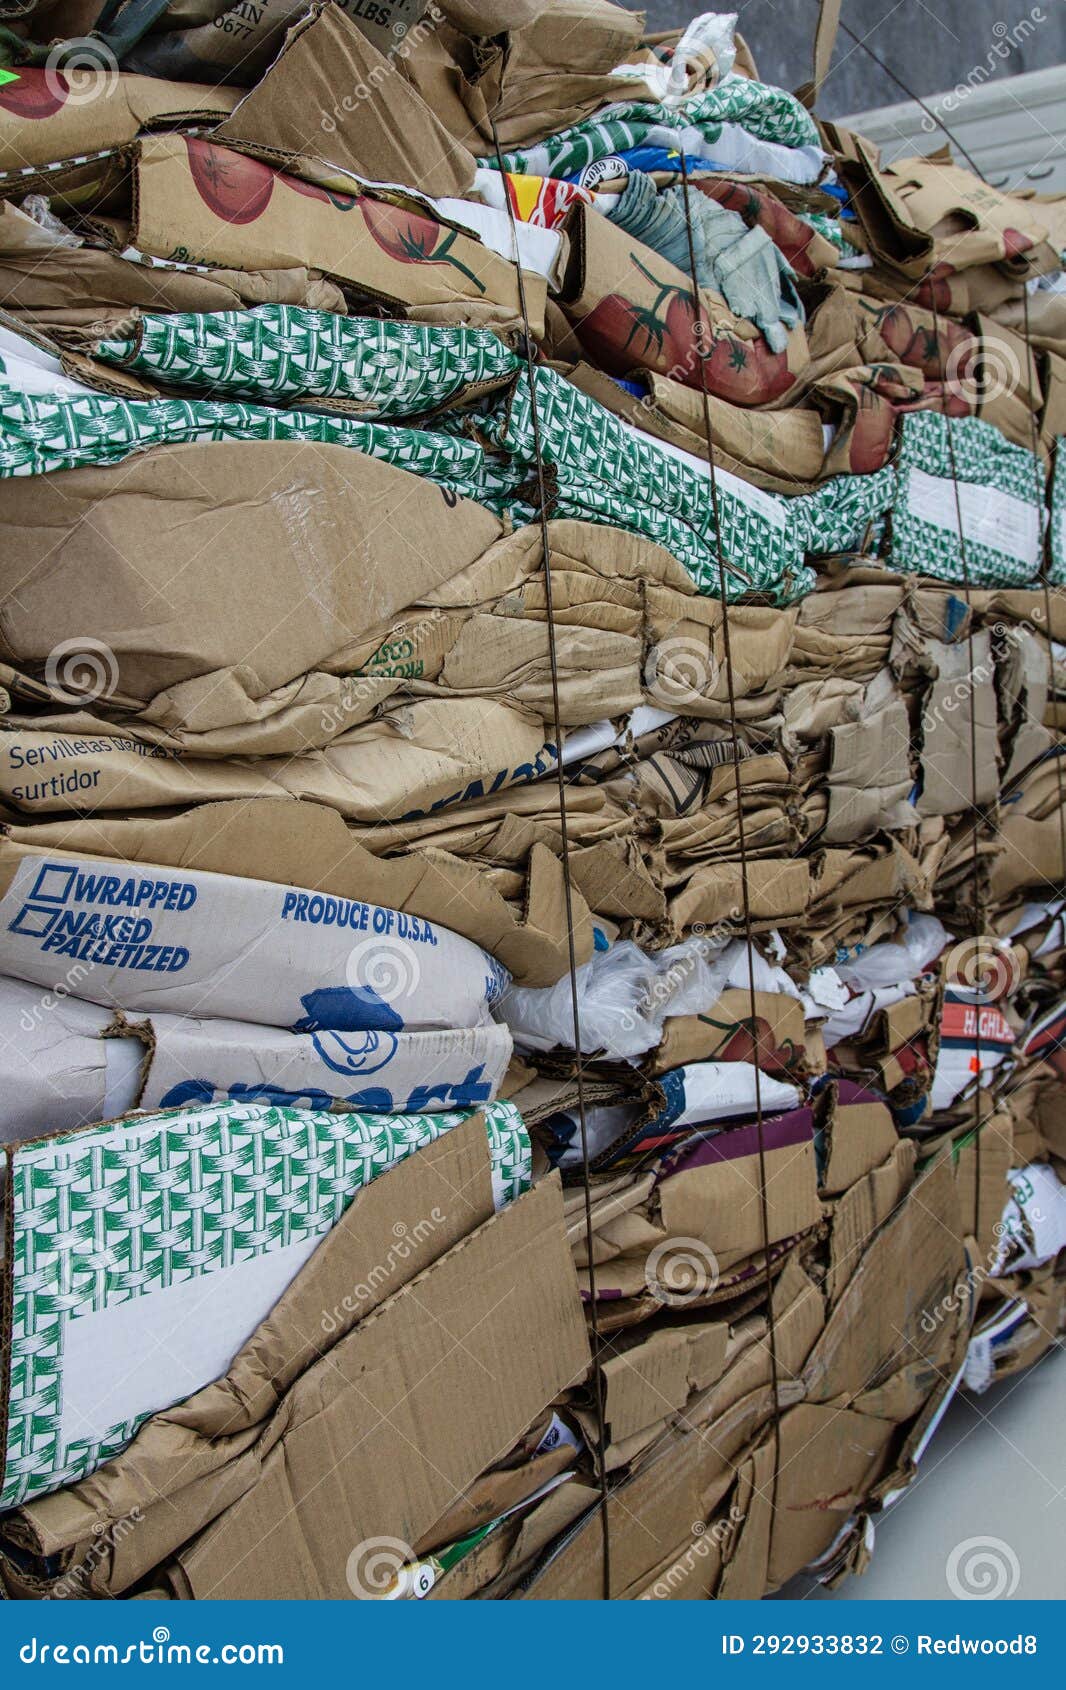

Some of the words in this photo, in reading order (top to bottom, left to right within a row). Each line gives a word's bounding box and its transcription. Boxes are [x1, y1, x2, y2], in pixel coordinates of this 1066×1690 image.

[9, 738, 113, 770] Servilletas
[11, 769, 101, 801] surtidor
[74, 873, 198, 912] WRAPPED
[54, 910, 153, 944] NAKED
[281, 892, 370, 931] PRODUCE
[372, 906, 395, 935] OF
[397, 911, 438, 946] U.S.A.
[41, 932, 191, 972] PALLETIZED
